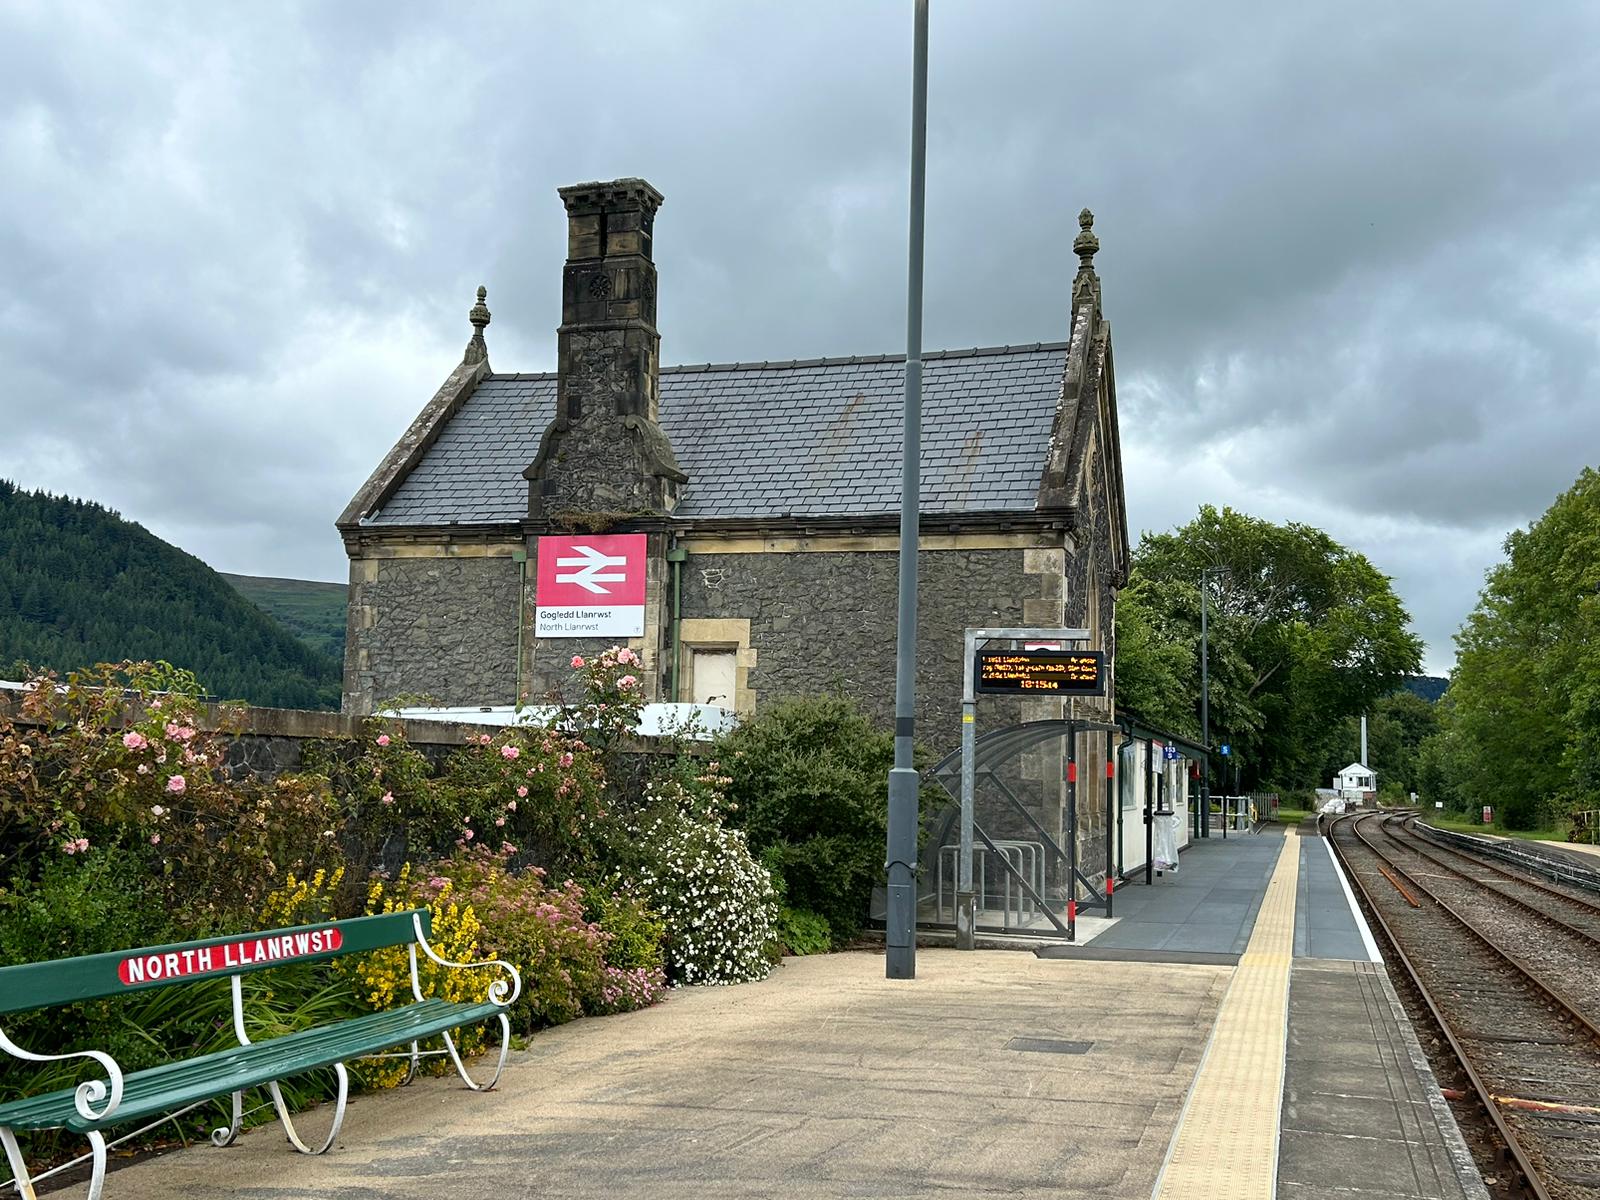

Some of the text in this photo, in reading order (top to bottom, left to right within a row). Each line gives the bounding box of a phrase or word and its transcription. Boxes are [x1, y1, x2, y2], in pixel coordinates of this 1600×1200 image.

[540, 610, 611, 620] Gogledd Llanrwst
[540, 622, 598, 631] North Llanrwst
[127, 929, 334, 983] NORTH LLANRWST
